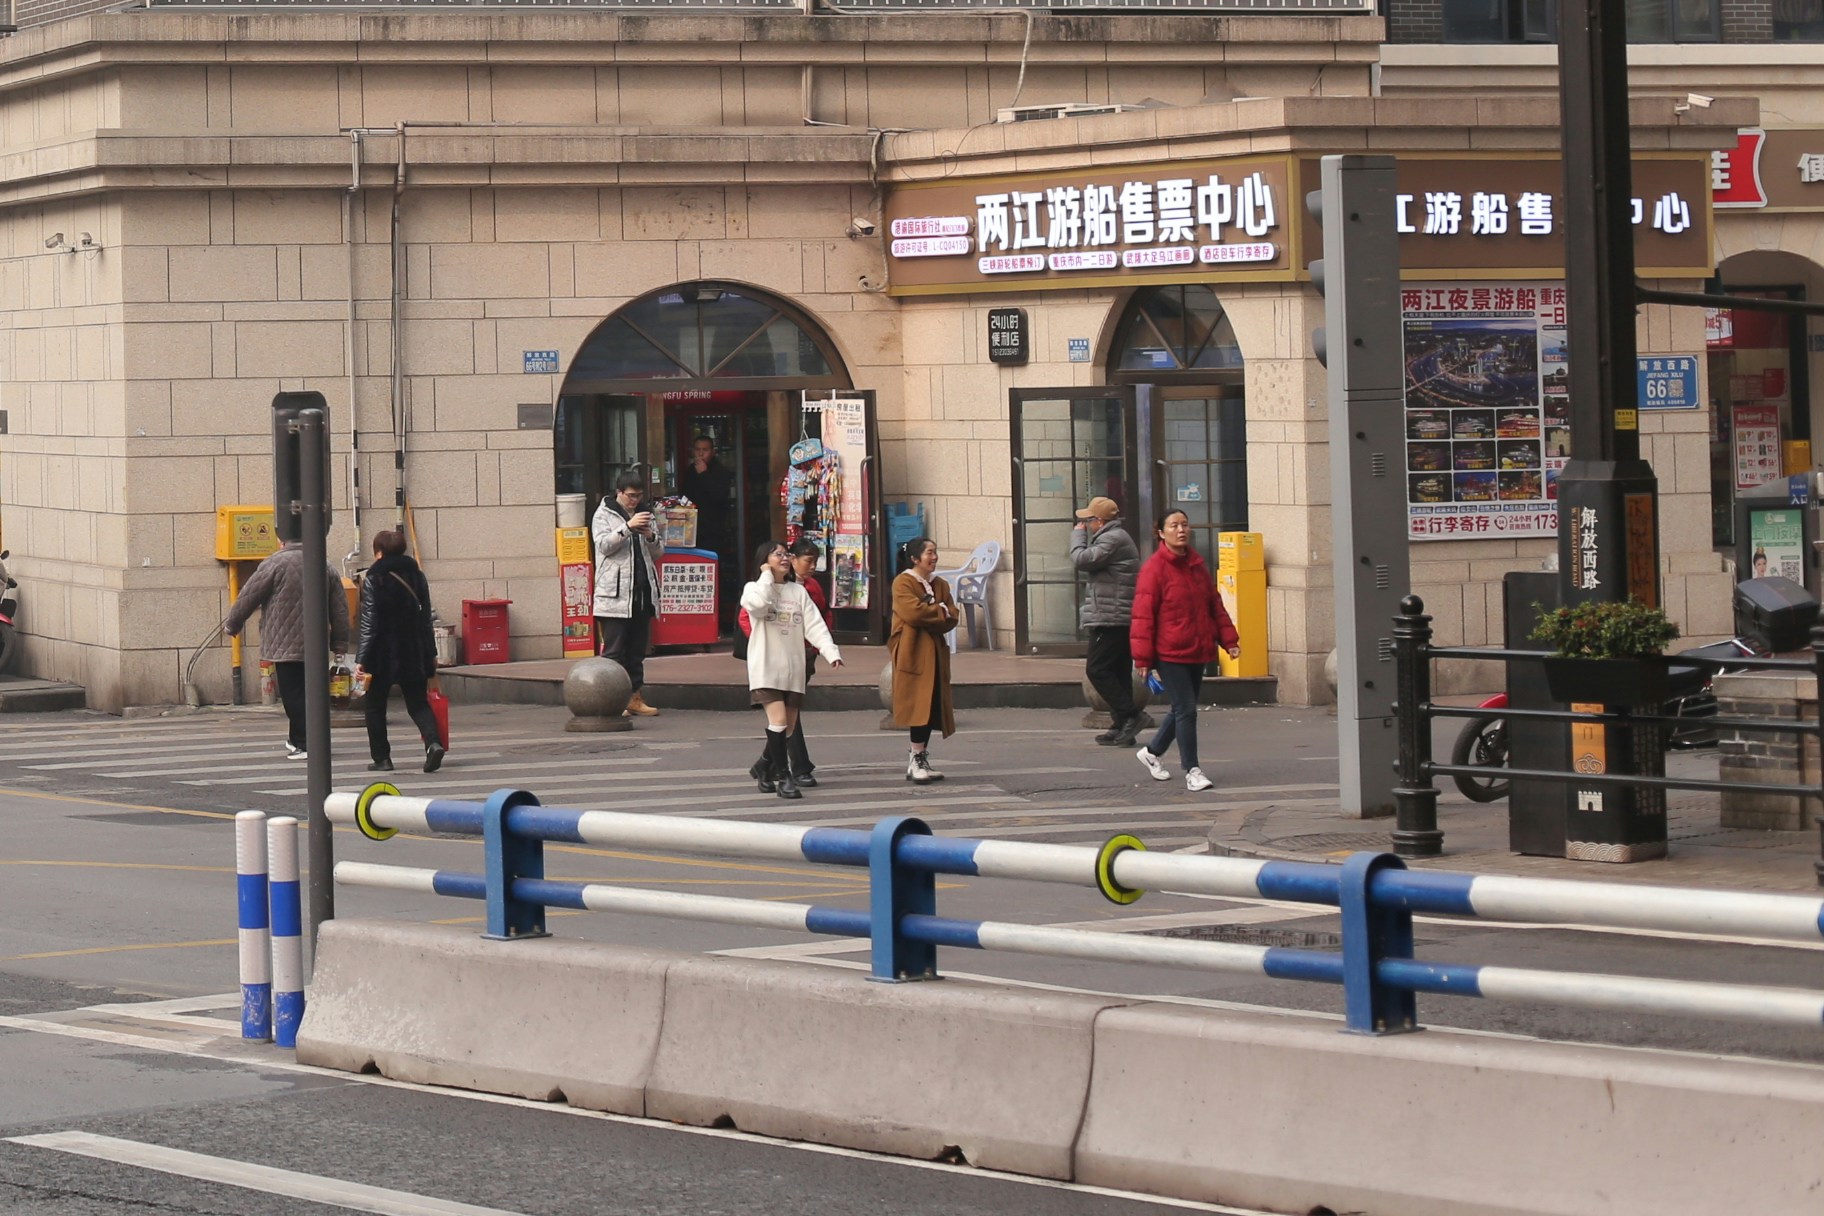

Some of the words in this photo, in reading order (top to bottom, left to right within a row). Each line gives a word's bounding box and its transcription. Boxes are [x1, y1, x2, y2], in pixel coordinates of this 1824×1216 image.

[976, 172, 1275, 252] 两江游船售票中心
[1204, 245, 1270, 260] 酒店包车行李寄存
[1401, 288, 1536, 311] 两江夜景游船
[1540, 288, 1565, 306] 重庆
[991, 314, 1019, 329] 24小时
[1540, 307, 1565, 324] 一日
[992, 331, 1020, 347] 便利店
[1639, 359, 1690, 372] 解放西路
[684, 390, 712, 400] SPRING
[1646, 380, 1667, 399] 66
[1791, 494, 1808, 505] 入口
[1429, 516, 1490, 534] 行李寄存
[1752, 524, 1802, 540] 上门按摩
[1580, 506, 1602, 590] 解放西路
